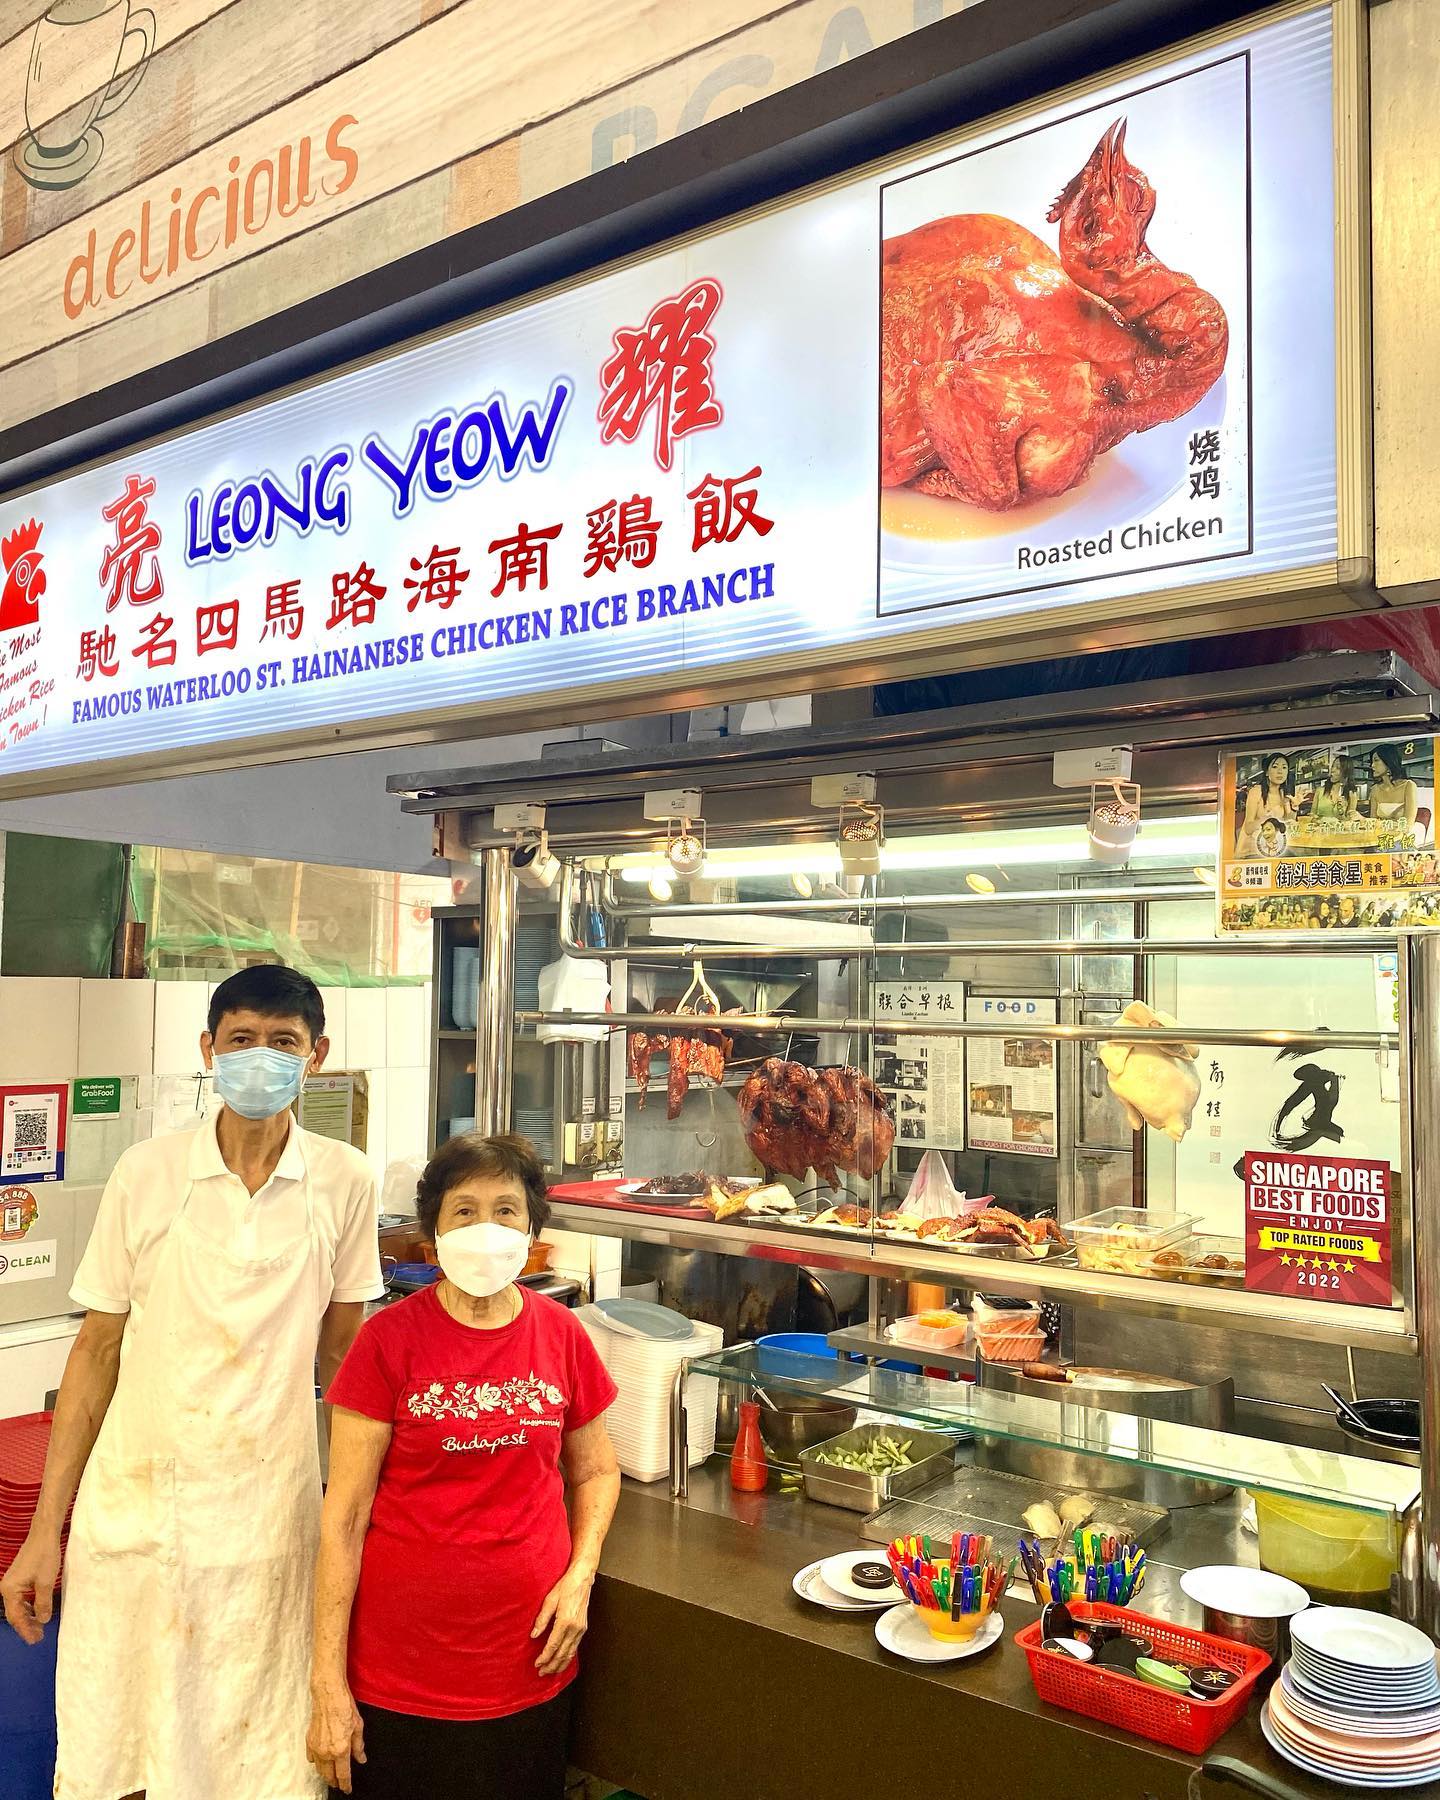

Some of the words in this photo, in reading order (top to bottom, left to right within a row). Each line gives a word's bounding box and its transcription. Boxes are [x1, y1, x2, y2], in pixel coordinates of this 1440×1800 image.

[63, 114, 359, 320] delicious
[599, 277, 723, 471] 耀
[187, 450, 351, 562] LEONG
[364, 385, 568, 511] YEOW
[1188, 430, 1220, 500] 烧鸡
[100, 474, 164, 613] 亮
[1018, 530, 1113, 570] Roasted
[1120, 516, 1223, 550] Chicken
[9, 626, 41, 661] Most
[72, 687, 142, 724] FAMOUS
[146, 668, 251, 710] WATERLOO
[256, 663, 286, 691] ST.
[292, 631, 424, 684] HAINANESE
[431, 609, 551, 659] CHICKEN
[560, 593, 628, 637] RICE
[636, 562, 776, 623] BRANCH
[29, 678, 56, 706] Rice
[1404, 742, 1415, 755] 8
[1364, 863, 1383, 873] 美食
[1369, 875, 1389, 886] 推荐
[879, 992, 955, 1011] 联合早报
[984, 1001, 1036, 1013] FOOD
[81, 1089, 115, 1097] GrabFood
[1251, 1161, 1384, 1194] SINGAPORE
[1254, 1187, 1304, 1211] BEST
[1311, 1192, 1380, 1219] FOODS
[1289, 1216, 1344, 1231] ENJOY
[1270, 1231, 1290, 1242] TOP
[1293, 1233, 1326, 1247] RATED
[1329, 1237, 1364, 1251] FOODS
[10, 1255, 51, 1268] CLEAN
[1297, 1271, 1340, 1289] 2022
[442, 1429, 528, 1454] Budapest
